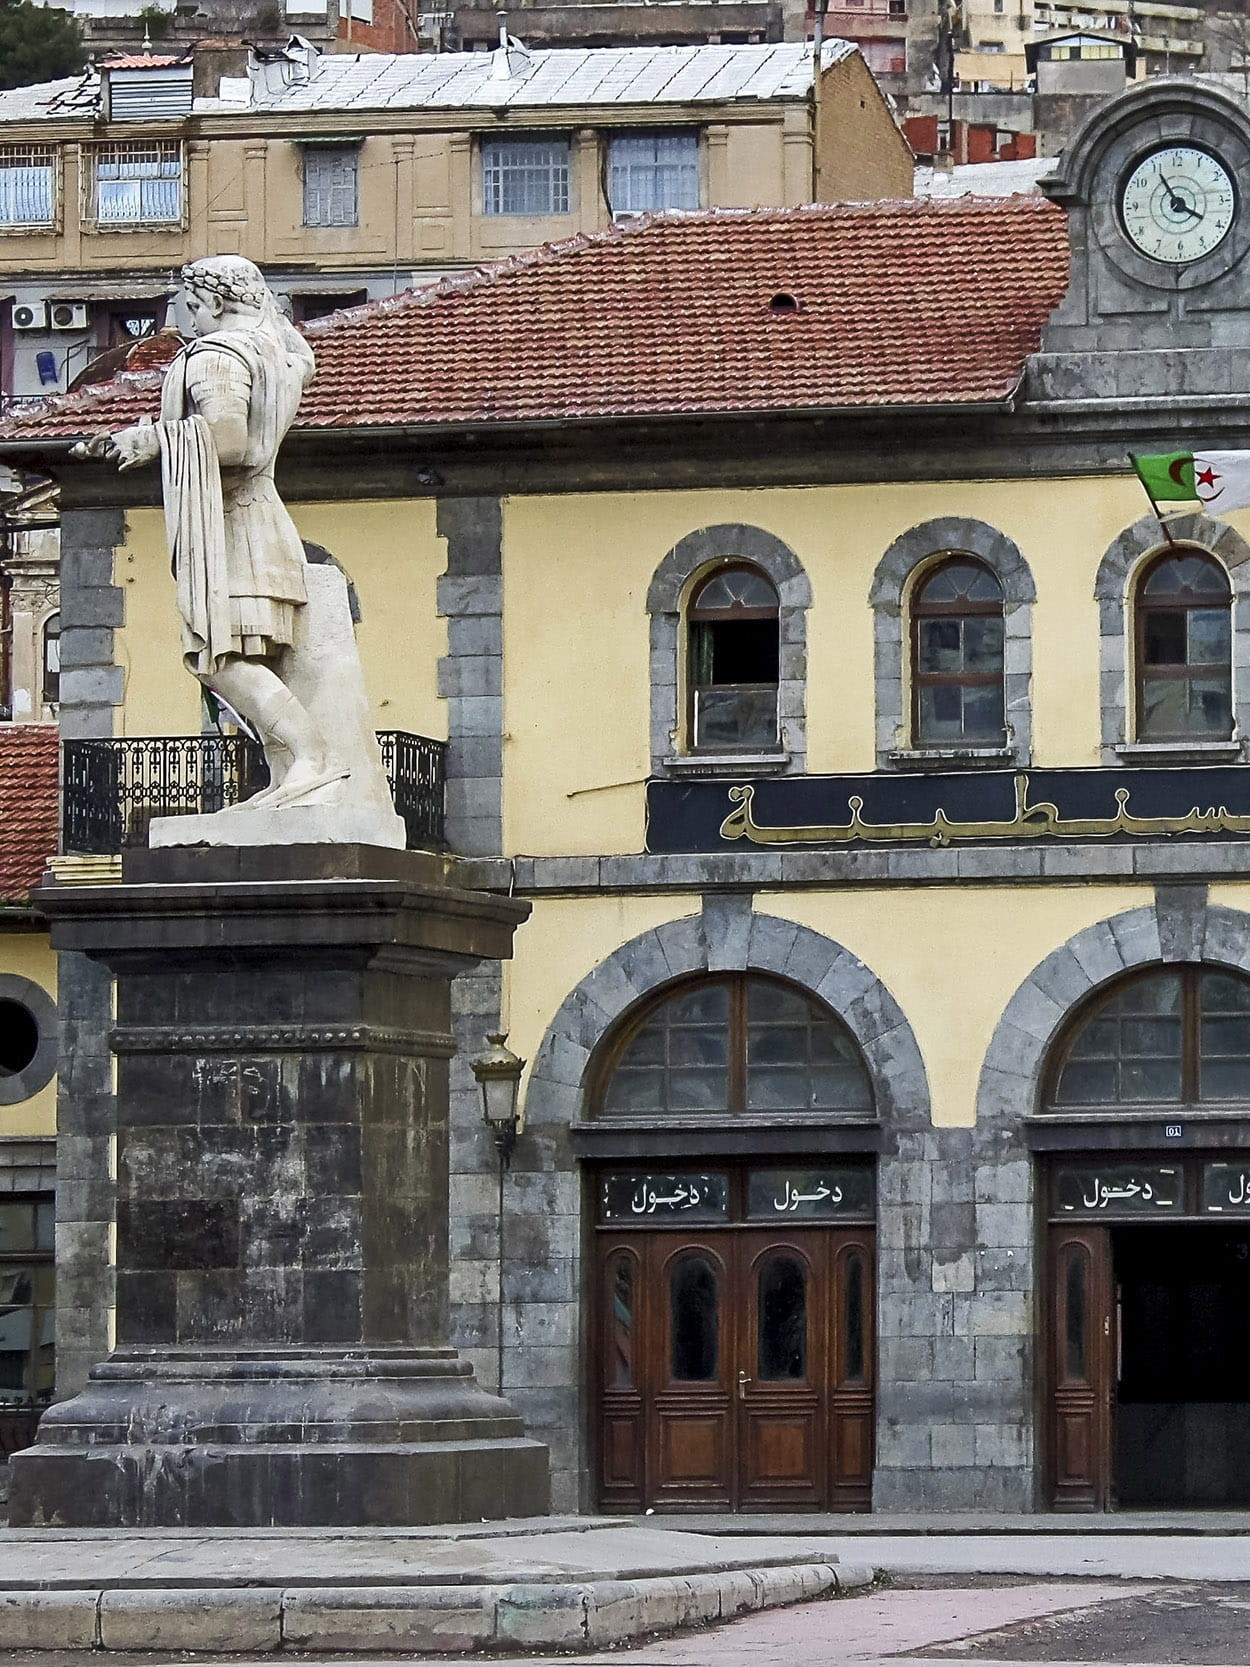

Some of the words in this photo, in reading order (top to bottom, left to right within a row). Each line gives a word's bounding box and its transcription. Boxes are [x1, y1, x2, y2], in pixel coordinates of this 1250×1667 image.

[1172, 156, 1183, 168] 12
[1152, 163, 1163, 174] 11
[1212, 171, 1220, 182] 2
[1136, 178, 1147, 188] 10
[1132, 201, 1139, 211] 9
[1218, 195, 1225, 206] 3
[1215, 219, 1225, 229] 4
[1138, 225, 1145, 236] 8
[1156, 239, 1162, 250] 7
[1177, 241, 1184, 251] 6
[1199, 236, 1205, 247] 5
[1168, 1127, 1179, 1136] 01
[632, 1181, 700, 1213] دخول
[773, 1180, 843, 1211] دخول
[1083, 1178, 1153, 1208] دخول
